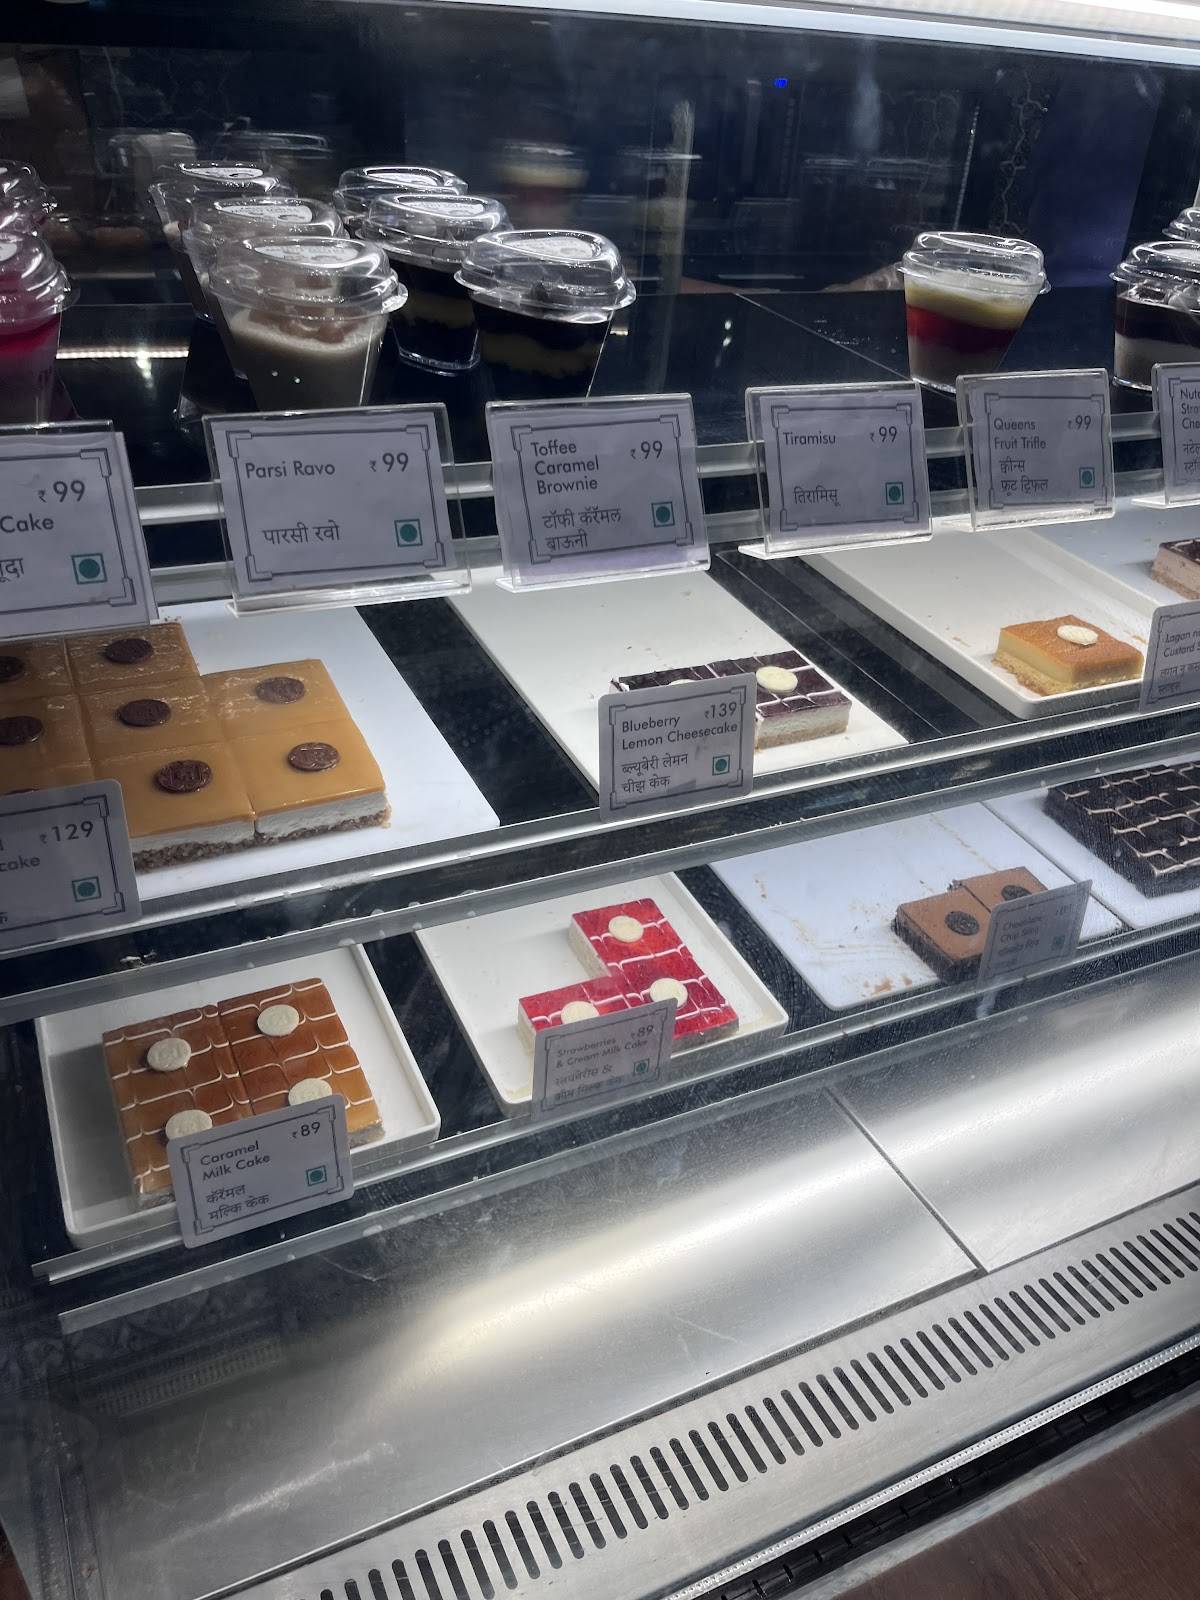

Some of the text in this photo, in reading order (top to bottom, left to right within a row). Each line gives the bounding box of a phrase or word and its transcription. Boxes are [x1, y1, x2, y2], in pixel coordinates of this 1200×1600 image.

[993, 417, 1036, 431] Queens
[782, 430, 836, 446] Tiramisu
[869, 425, 897, 443] ₹99
[994, 436, 1047, 450] Fruit Trifle
[530, 439, 577, 457] Toffee
[630, 440, 663, 460] ₹99
[245, 460, 336, 479] Parsi Ravo
[369, 451, 410, 474] ₹99
[534, 455, 600, 476] Caramel
[37, 479, 87, 503] ₹99
[536, 475, 599, 495] Brownie
[0, 513, 55, 534] Cake
[542, 508, 575, 529] टॉफी
[262, 519, 340, 546] पारसी रवो
[1164, 631, 1191, 644] Lagan
[704, 701, 738, 719] ₹139
[621, 716, 681, 733] Blueberry
[621, 721, 738, 751] Lemon Cheesecake
[662, 752, 689, 768] लेमन
[649, 773, 671, 789] केक
[39, 820, 94, 845] ₹129
[556, 1037, 617, 1058] Strawberries
[567, 1053, 600, 1066] Cream
[602, 1047, 621, 1058] Milk
[291, 1121, 321, 1140] ₹89
[200, 1140, 259, 1166] Caramel
[202, 1154, 271, 1181] Milk Cake
